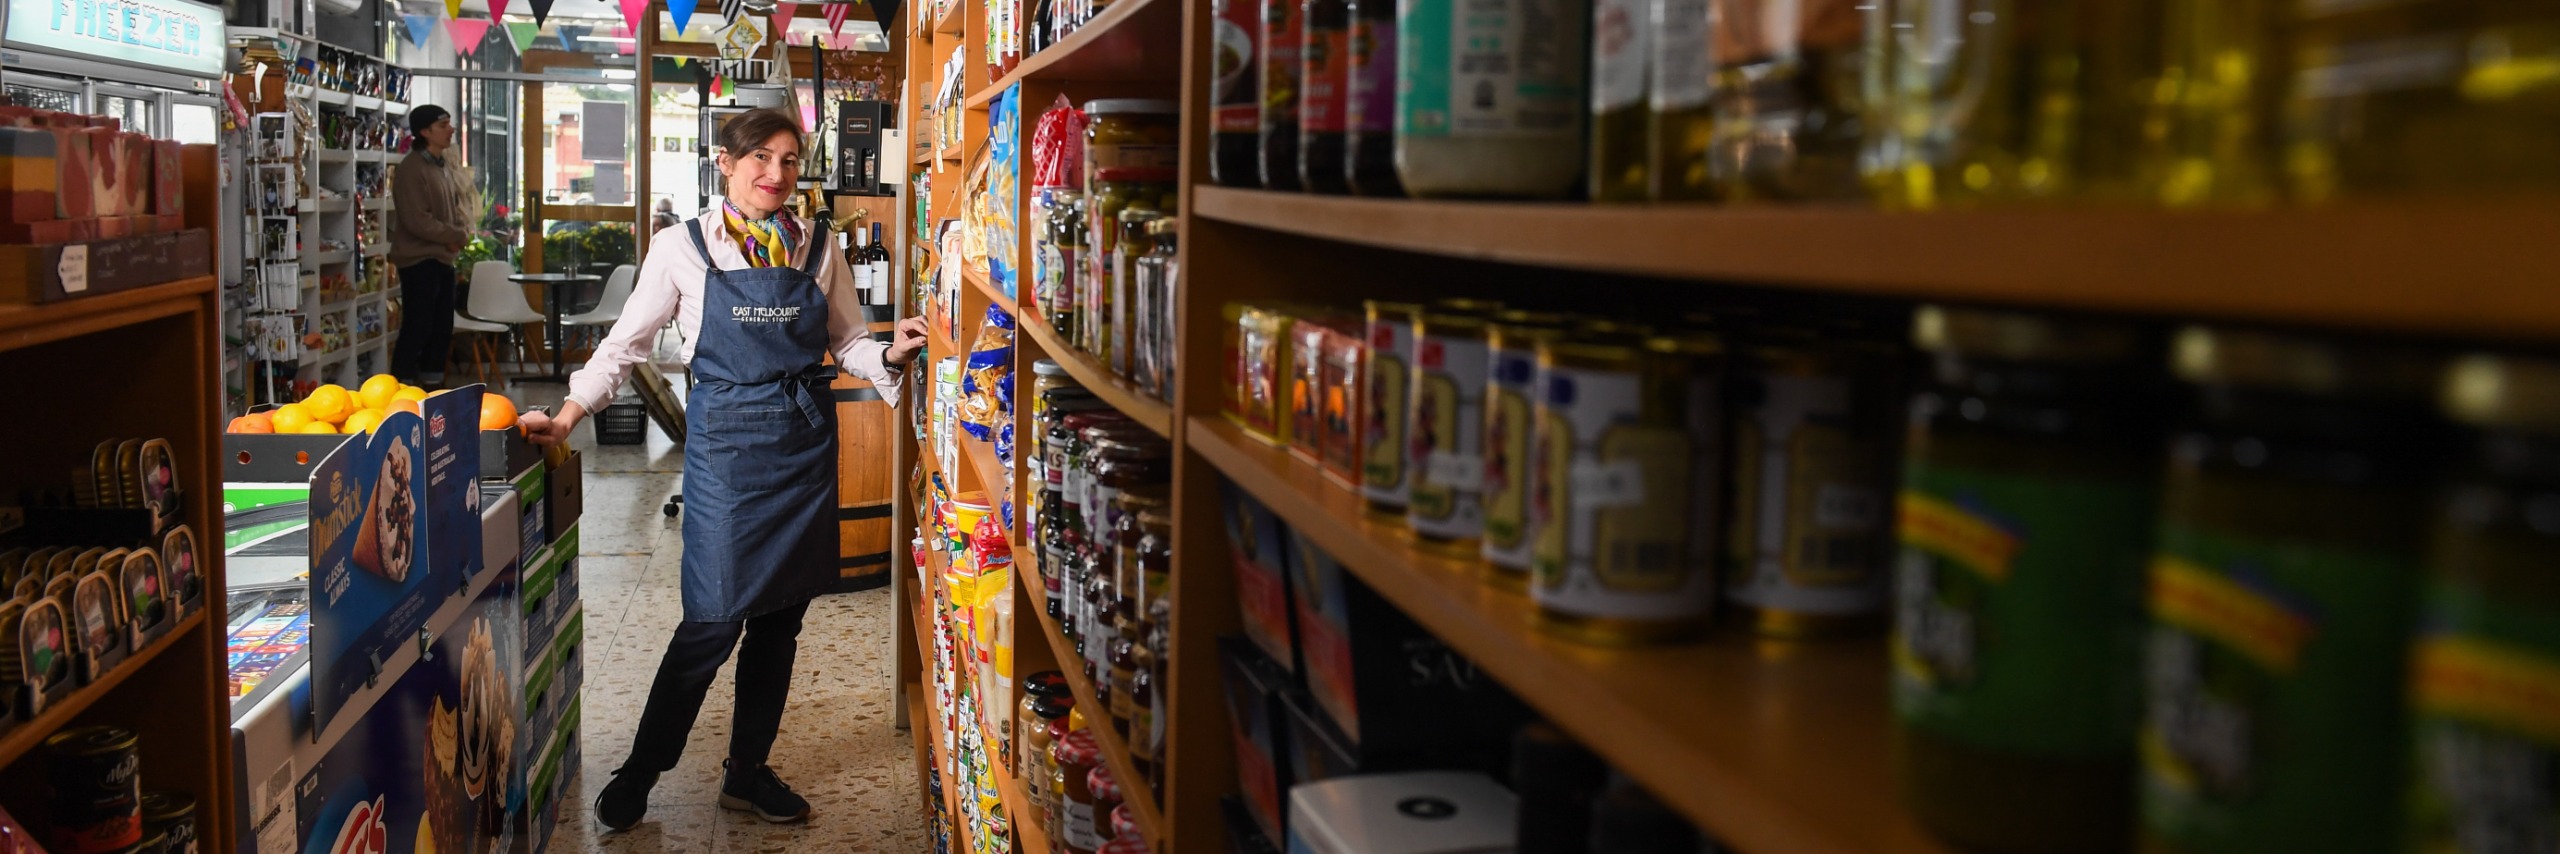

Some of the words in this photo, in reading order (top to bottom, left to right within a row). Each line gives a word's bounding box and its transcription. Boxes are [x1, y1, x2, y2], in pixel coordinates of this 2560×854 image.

[51, 0, 201, 56] FREEZER
[732, 306, 751, 317] EAST
[753, 306, 800, 317] MELBOURNE
[313, 477, 362, 569] Drumstick
[324, 556, 346, 593] CLASSIC
[329, 571, 351, 609] ALWAYS
